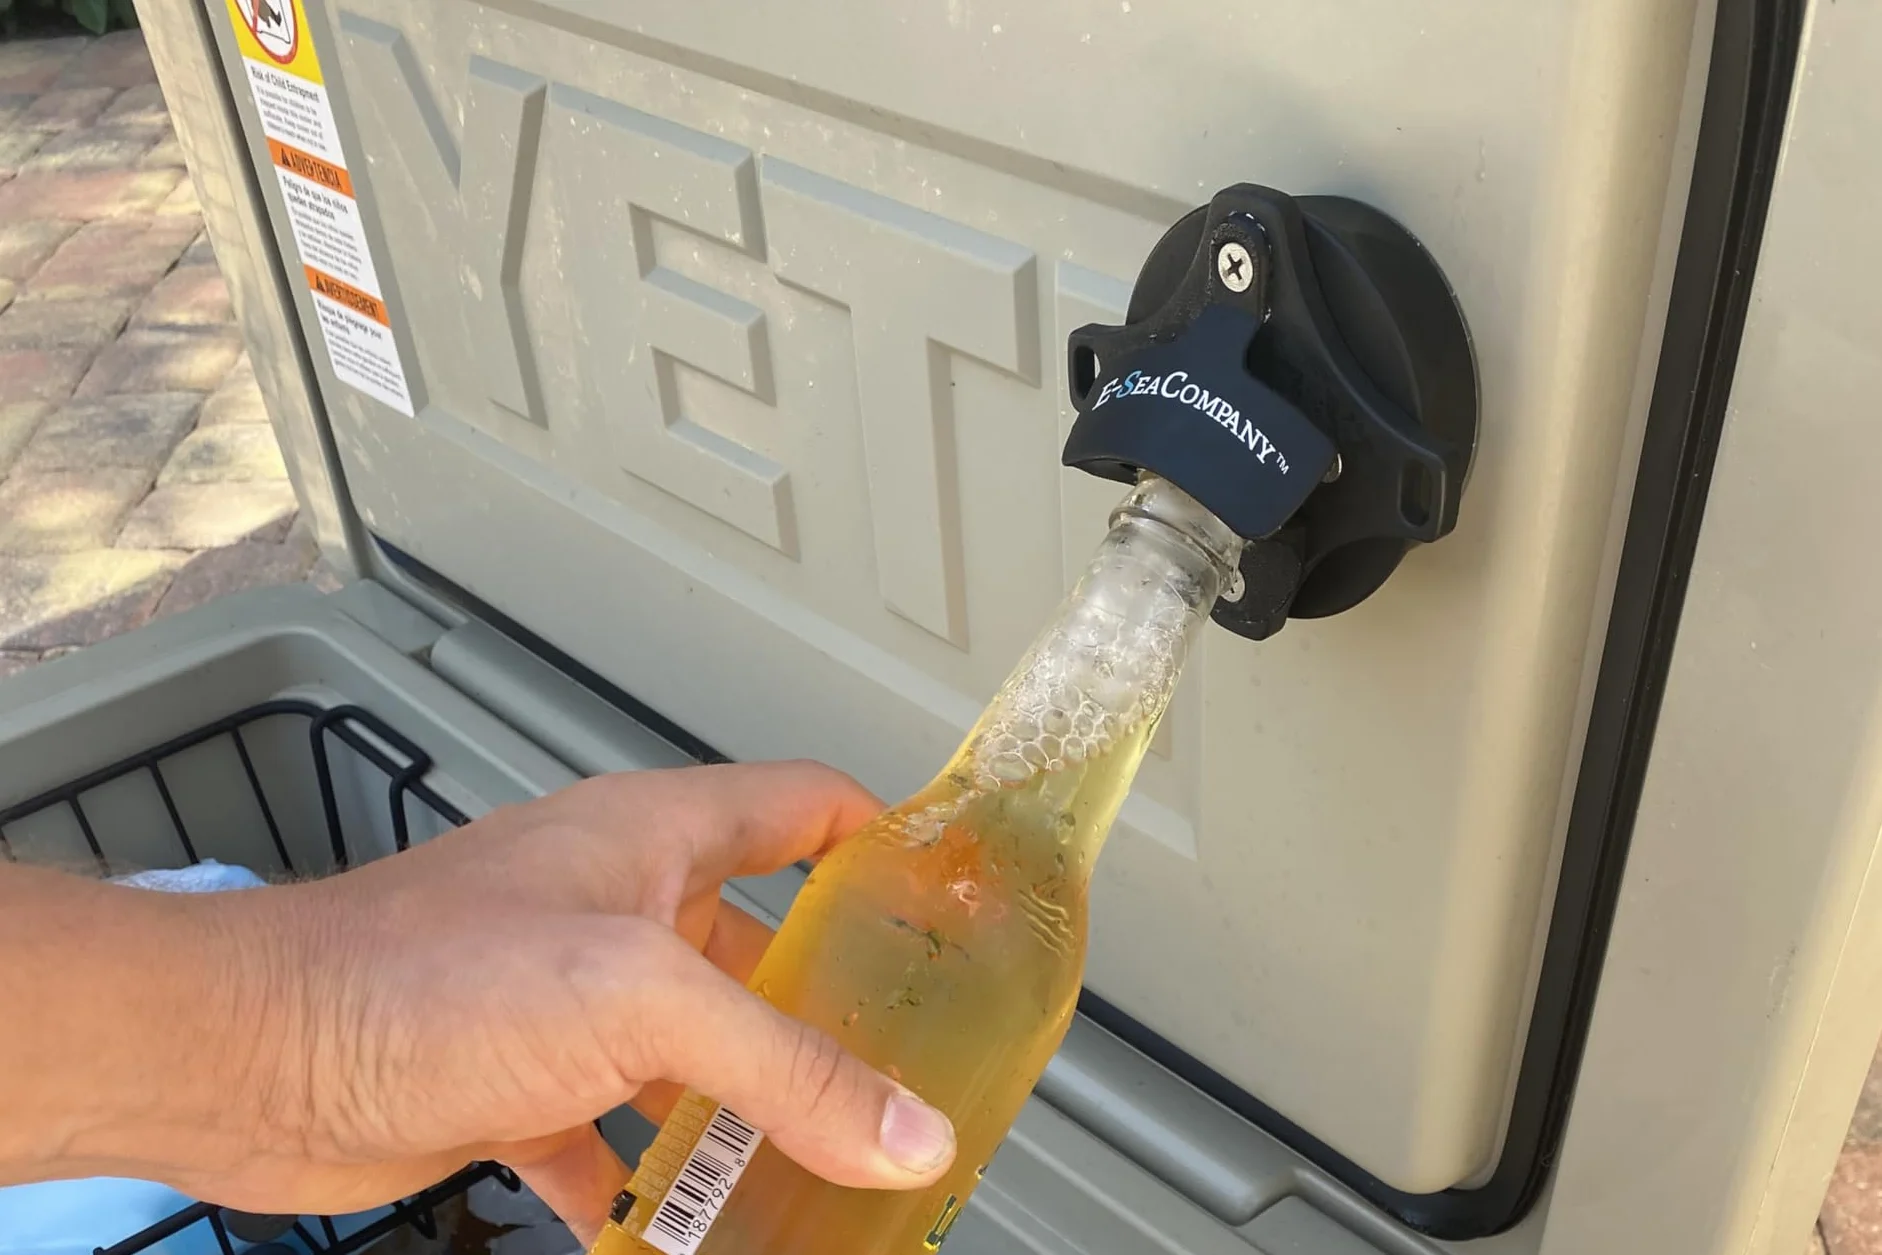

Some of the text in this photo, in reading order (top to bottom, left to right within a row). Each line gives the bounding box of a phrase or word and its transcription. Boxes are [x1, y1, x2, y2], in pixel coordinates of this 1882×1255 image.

[270, 73, 287, 89] Child
[290, 152, 343, 189] ADVERTENCIA
[324, 279, 378, 319] AVERTISSEMENT
[684, 1177, 733, 1239] 187792
[734, 1158, 745, 1167] 8
